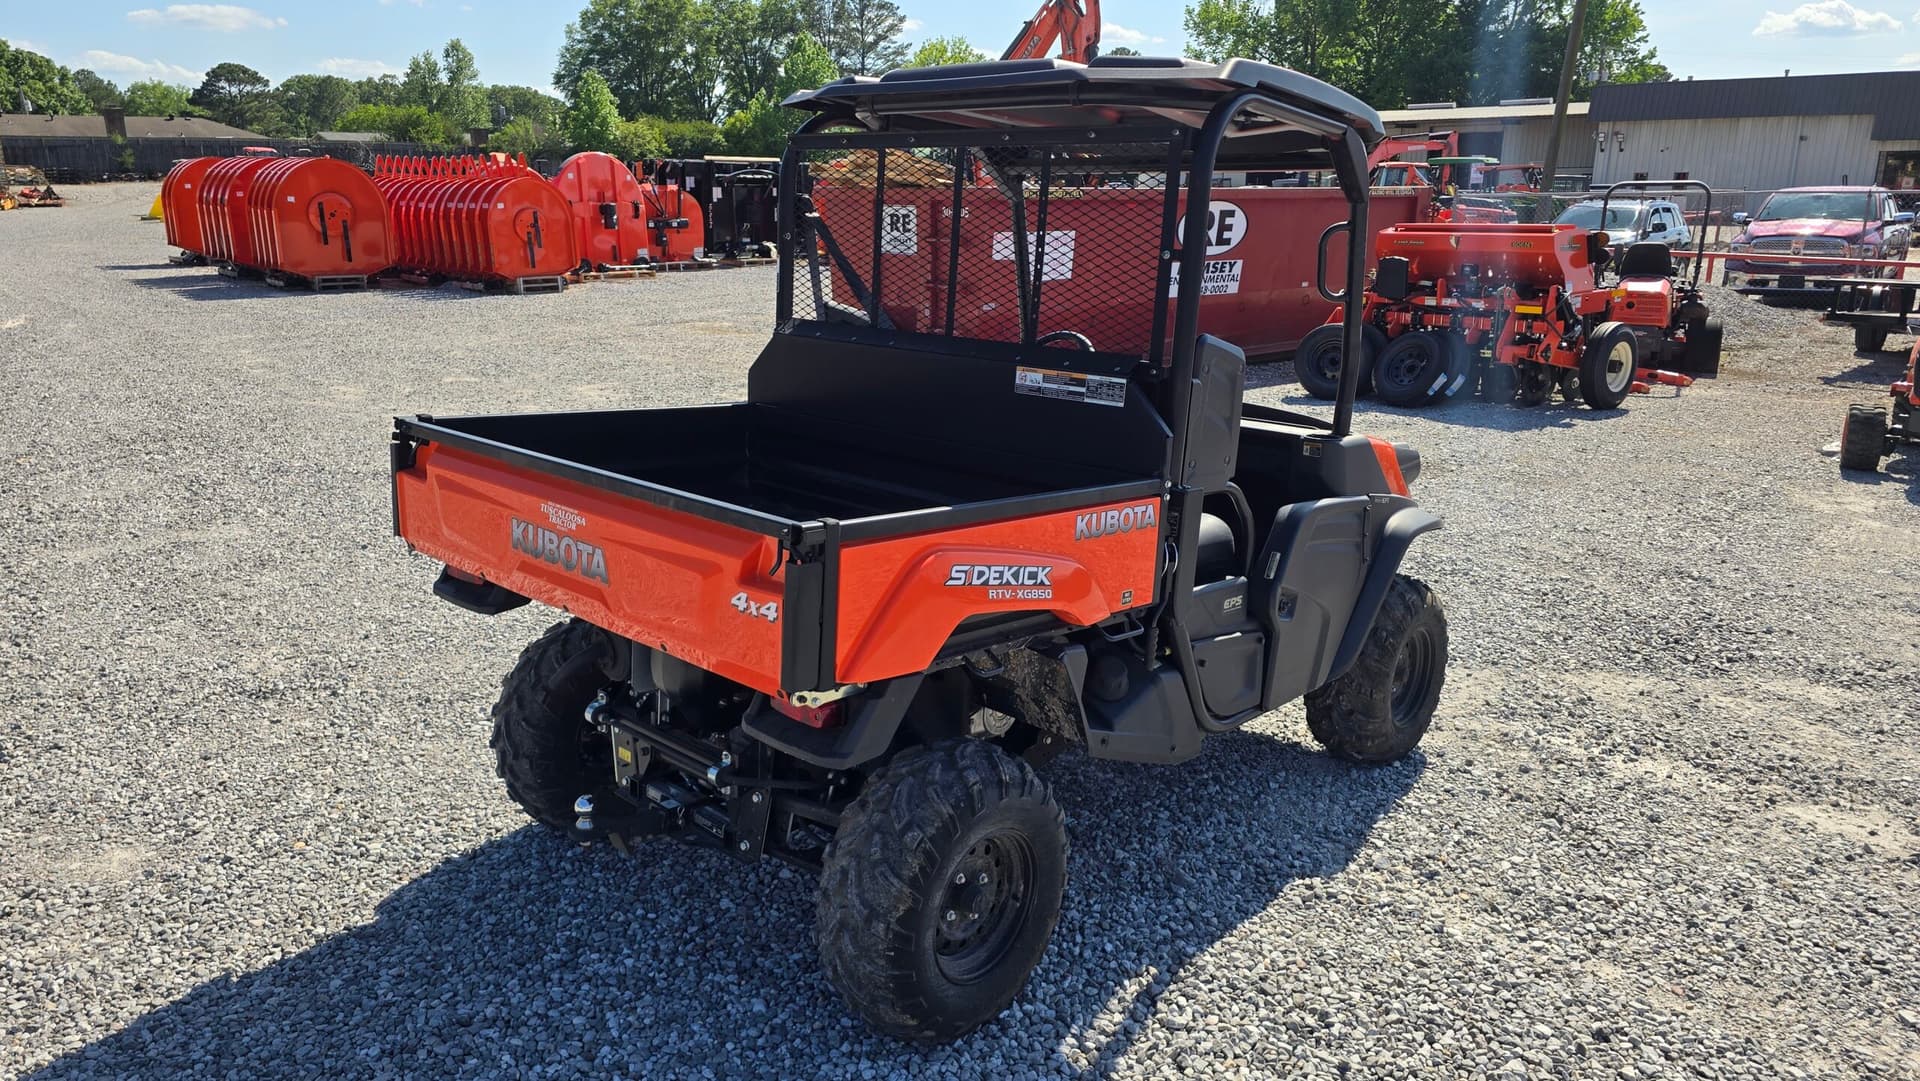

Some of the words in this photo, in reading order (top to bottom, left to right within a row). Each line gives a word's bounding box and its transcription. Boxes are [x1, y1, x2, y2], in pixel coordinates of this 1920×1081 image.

[541, 503, 586, 527] TUSCALOOSA
[549, 514, 577, 531] TRACTOR
[1075, 504, 1157, 541] KUBOTA
[511, 516, 610, 586] KUBOTA
[944, 565, 1053, 586] SIDEKICK
[988, 589, 1053, 599] RTV-XG850
[1223, 595, 1243, 609] EPS
[730, 591, 778, 623] 4x4
